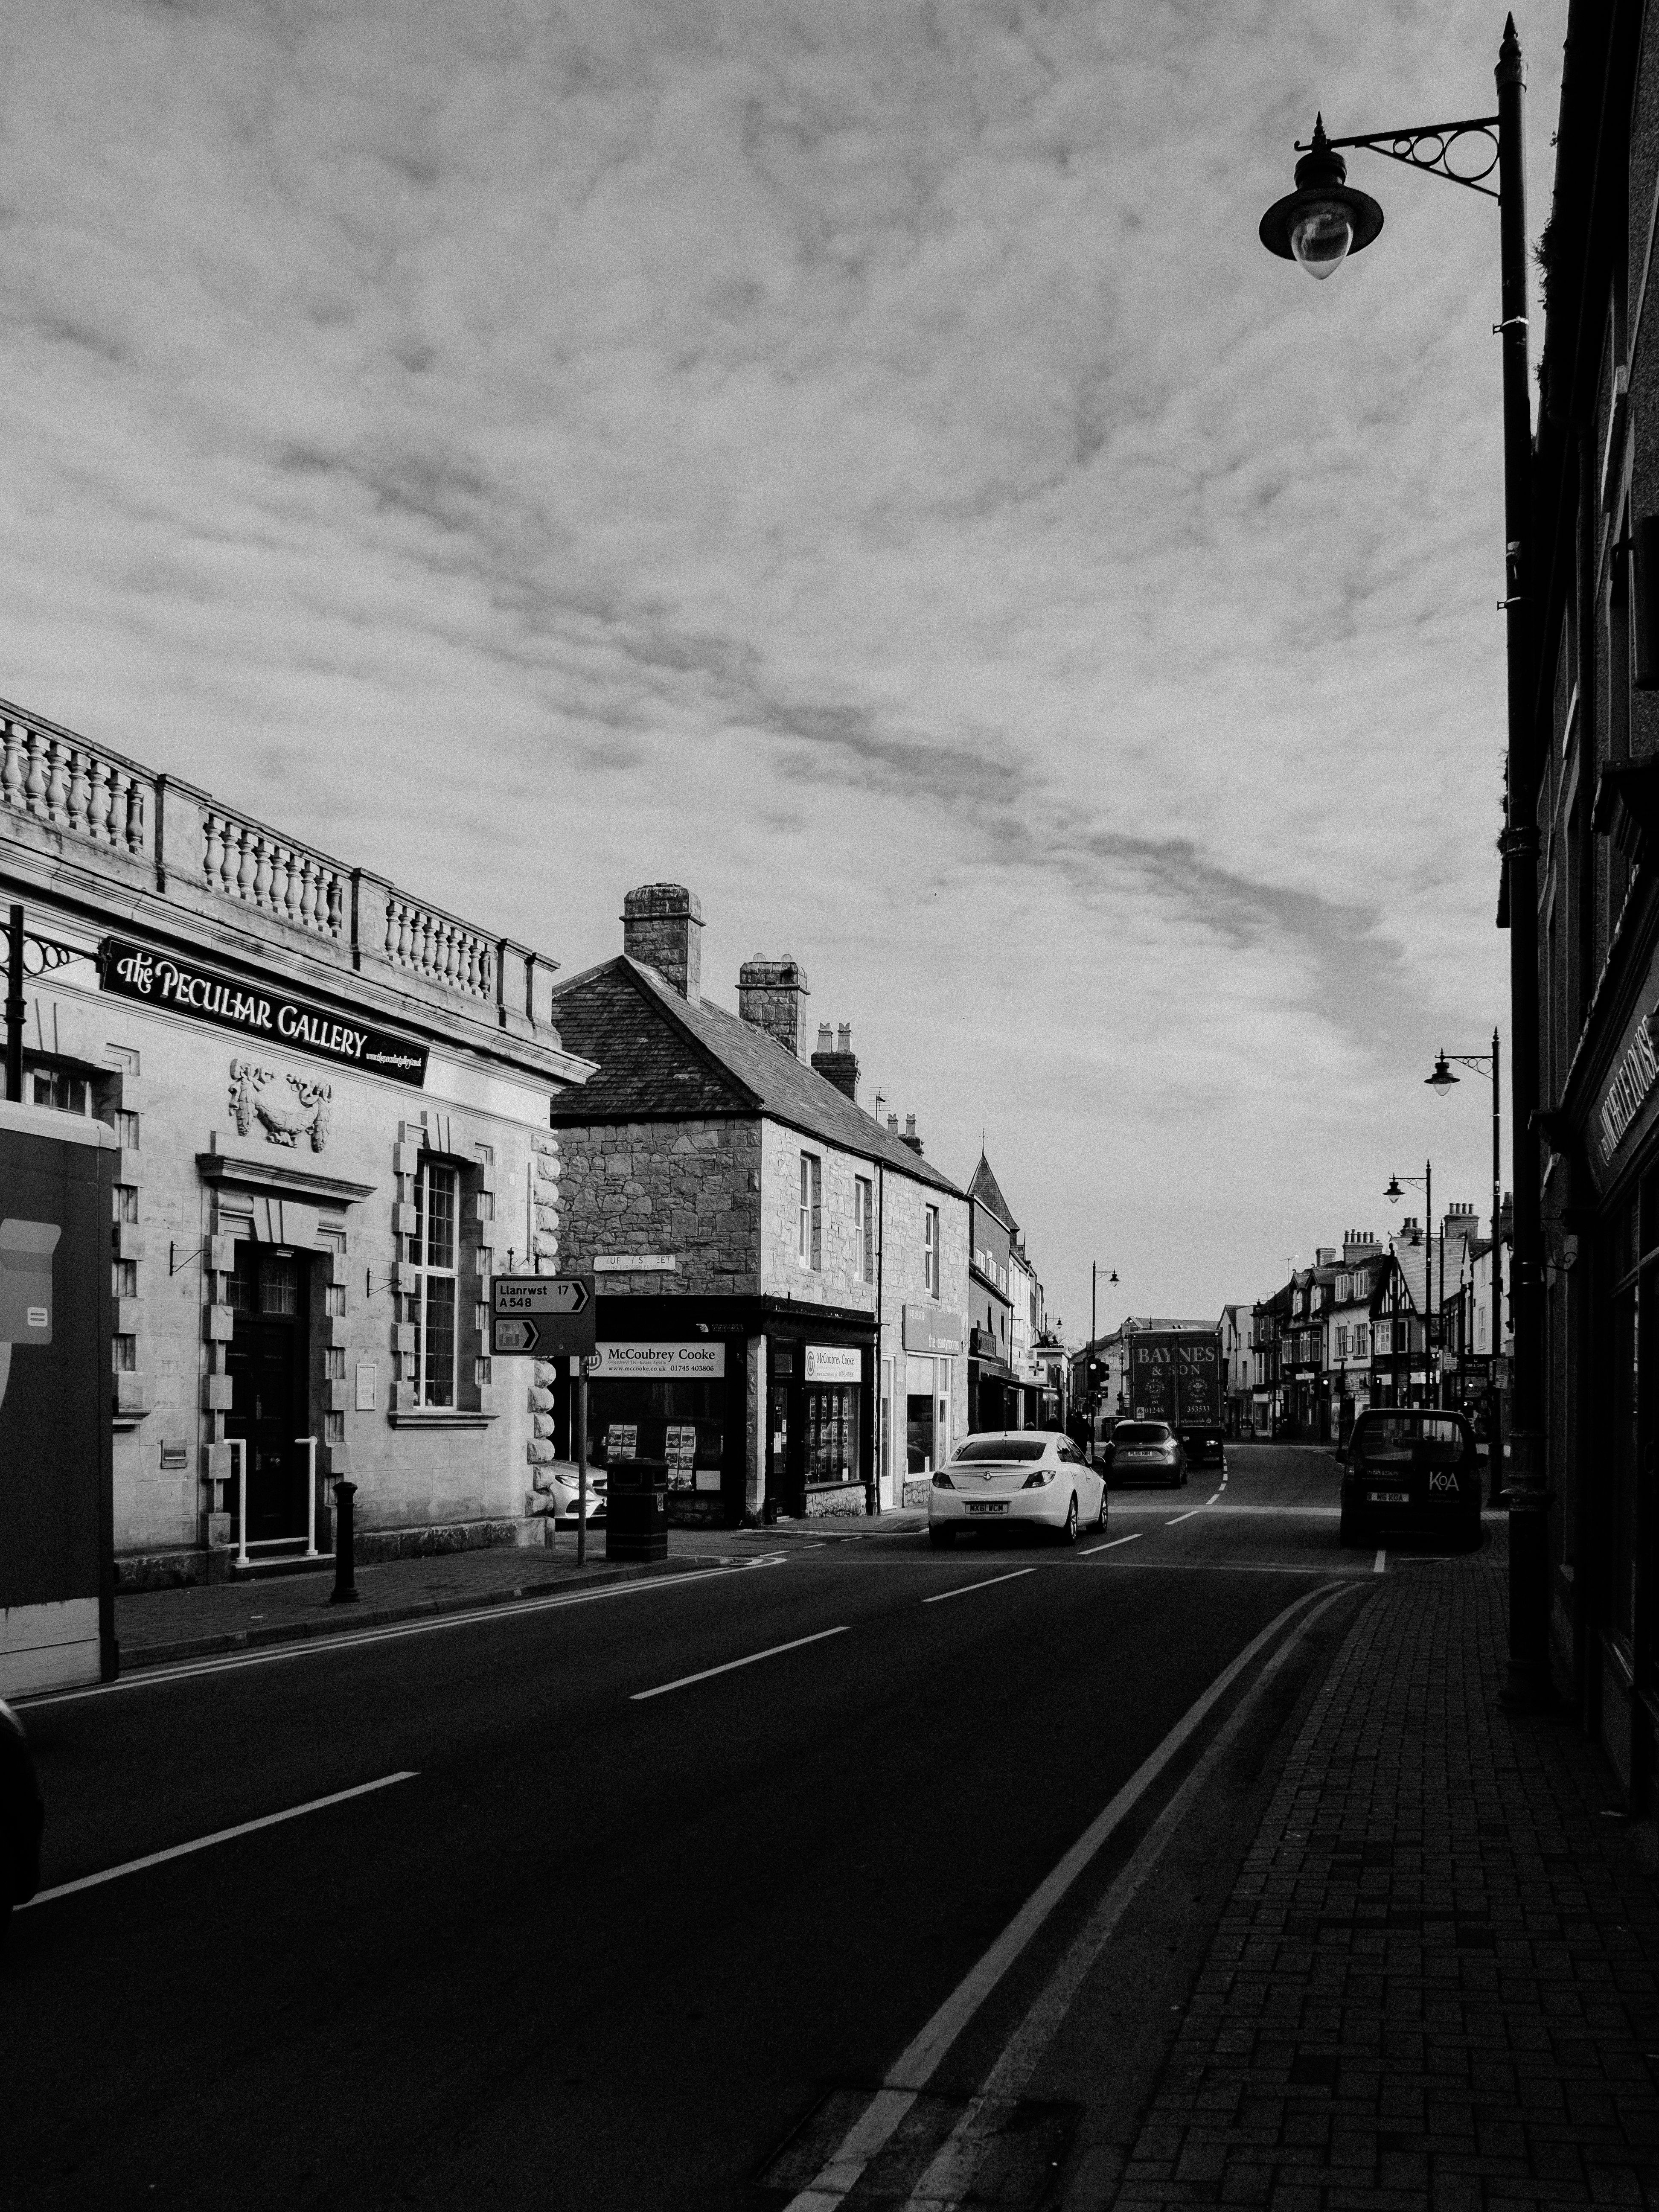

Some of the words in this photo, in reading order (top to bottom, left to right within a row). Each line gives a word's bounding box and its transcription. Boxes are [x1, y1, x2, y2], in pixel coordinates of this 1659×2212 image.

[116, 953, 153, 994] The
[155, 961, 273, 1030] PECULIAR
[277, 1005, 368, 1060] GALLERY
[500, 1285, 547, 1295] Llanrwst
[558, 1285, 569, 1295] 17
[608, 1348, 675, 1362] McCoubrey
[678, 1349, 715, 1359] Cooke
[817, 1353, 841, 1368] McCoubrey
[842, 1354, 854, 1365] Cooke
[1138, 1347, 1215, 1363] BAYNES
[1152, 1365, 1162, 1376] &
[1429, 1471, 1460, 1491] KoA
